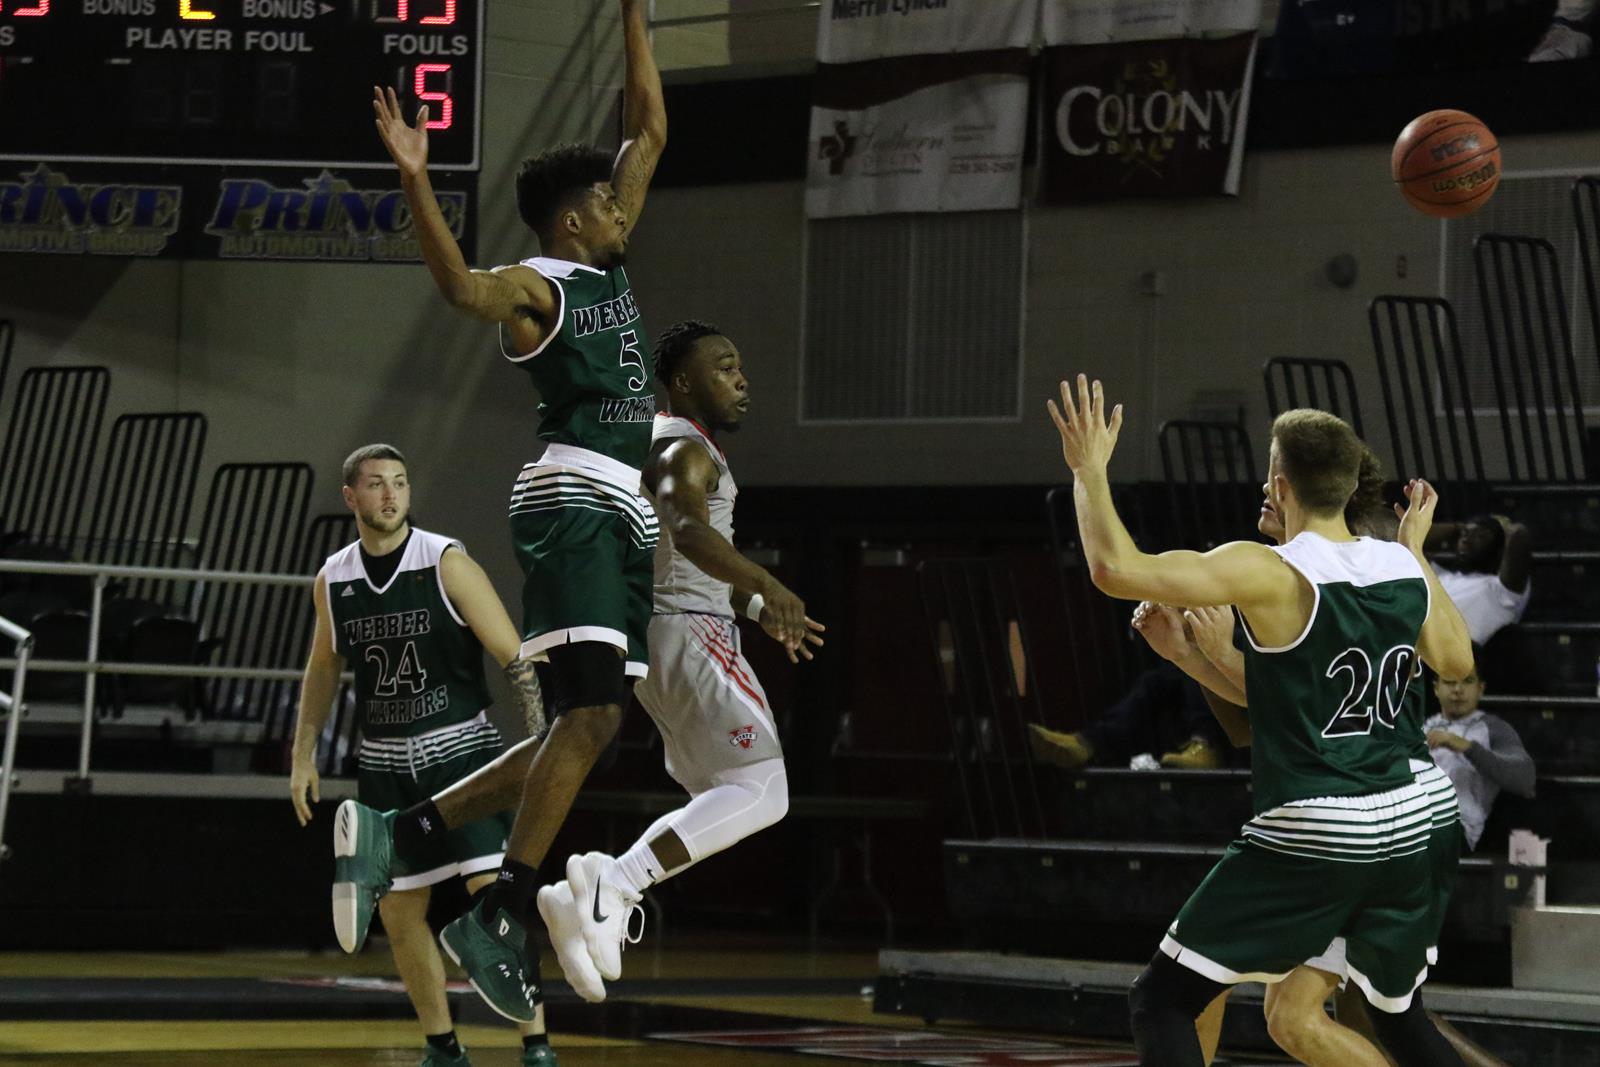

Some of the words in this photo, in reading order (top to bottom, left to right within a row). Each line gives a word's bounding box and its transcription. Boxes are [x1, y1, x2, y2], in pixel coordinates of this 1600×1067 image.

[82, 0, 156, 16] BONUS
[242, 0, 315, 19] BONUS
[126, 30, 233, 51] PLAYER
[244, 32, 314, 53] FOUL
[383, 34, 469, 56] FOULS
[414, 63, 453, 130] 5
[1055, 85, 1240, 156] COLONY
[222, 236, 368, 257] AUTOMOTIVE
[619, 329, 648, 391] 5
[365, 640, 427, 696] 24
[365, 684, 449, 725] WARRIORS
[1321, 644, 1417, 739] 20
